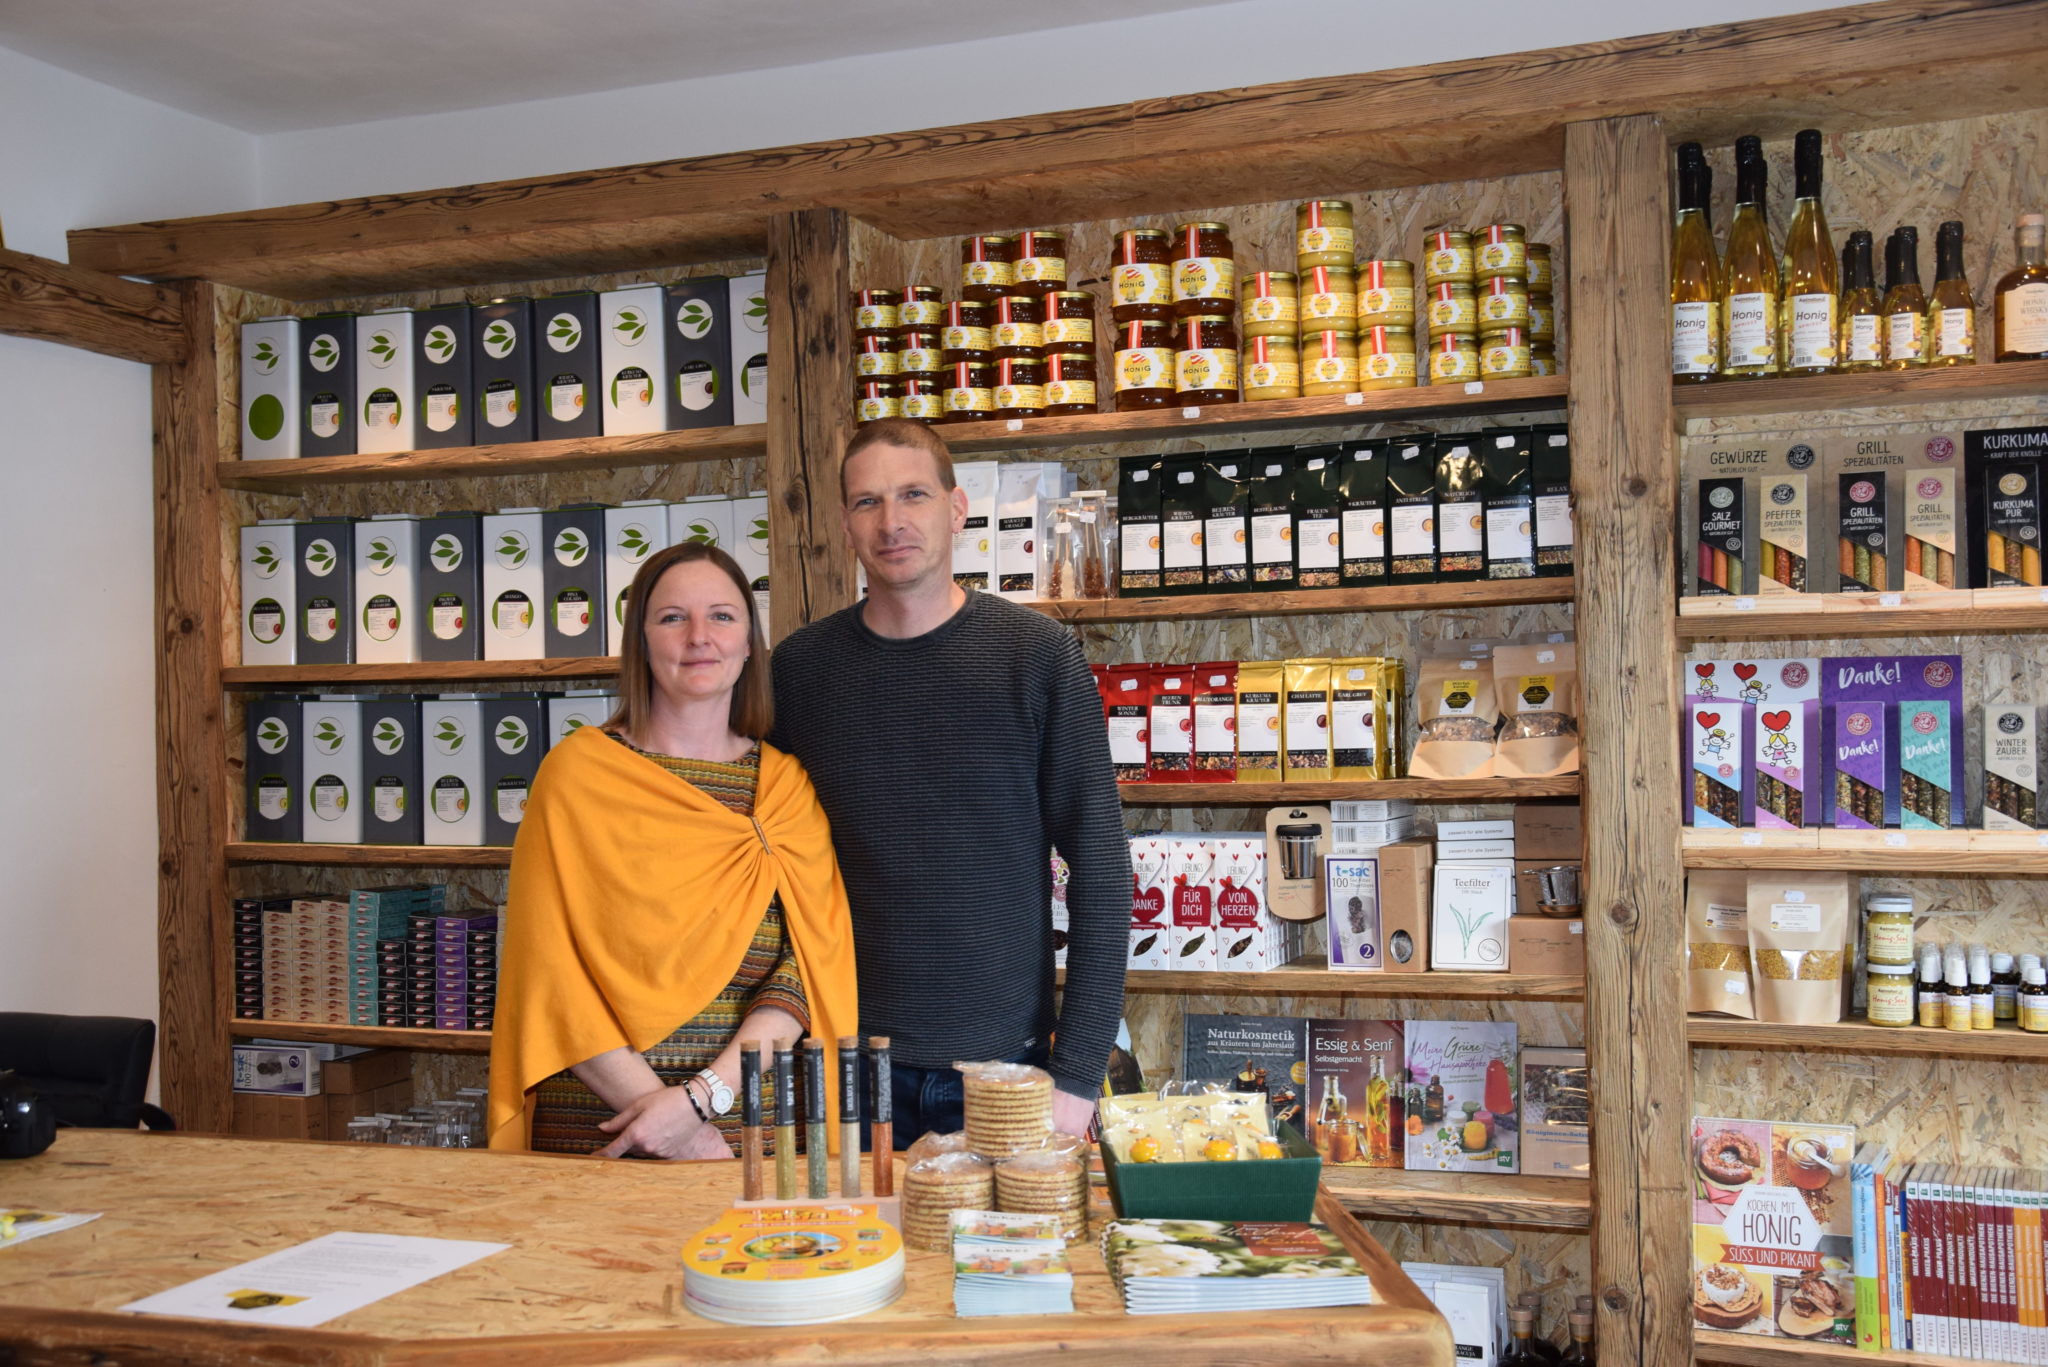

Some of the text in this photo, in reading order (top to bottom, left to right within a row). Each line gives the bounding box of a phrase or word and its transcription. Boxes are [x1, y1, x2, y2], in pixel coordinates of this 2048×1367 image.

[1119, 280, 1146, 289] HONIG
[1179, 275, 1207, 284] HONIG
[1732, 310, 1763, 321] Honig
[1796, 311, 1827, 321] Honig
[1675, 319, 1706, 329] Honig
[1123, 365, 1151, 373] HONIG
[1183, 366, 1210, 375] HONIG
[1983, 432, 2048, 450] KURKUMA
[1857, 440, 1891, 454] GRILL
[1710, 448, 1768, 465] GEWÜRZE
[1843, 455, 1904, 467] SPEZIALITÄTEN
[1917, 504, 1943, 514] GRILL
[1993, 500, 2034, 510] KURKUMA
[1711, 511, 1731, 521] SALZ
[1765, 509, 1801, 520] PFEFFER
[1850, 507, 1875, 517] GRILL
[2005, 508, 2022, 517] PUR
[1702, 520, 1741, 531] GOURMET
[1838, 661, 1901, 689] Danke!
[1995, 738, 2027, 747] WINTER
[1838, 738, 1879, 761] Danke!
[1904, 737, 1946, 760] Danke!
[1995, 747, 2027, 755] ZAUBER
[1335, 864, 1370, 877] t-sac
[1332, 877, 1349, 888] 100
[1453, 878, 1491, 887] Teefilter
[1183, 888, 1201, 903] FÜR
[1228, 892, 1248, 903] VON
[1182, 904, 1203, 916] DICH
[1221, 904, 1256, 916] HERZEN
[1363, 944, 1372, 957] 2
[1207, 1028, 1295, 1041] Naturkosmetik
[1262, 1041, 1296, 1049] Jahreslauf
[1315, 1037, 1393, 1053] Essig & Senf
[1414, 1036, 1482, 1061] Meine Grüne
[1314, 1054, 1363, 1064] Selbstgemacht
[1429, 1054, 1487, 1073] Hausapotheke
[1499, 1155, 1511, 1163] stv
[1747, 1199, 1796, 1214] KOCHEN MIT
[1743, 1213, 1802, 1246] HONIG
[1729, 1246, 1817, 1268] SÜSS UND PIKANT
[1835, 1322, 1850, 1331] stv
